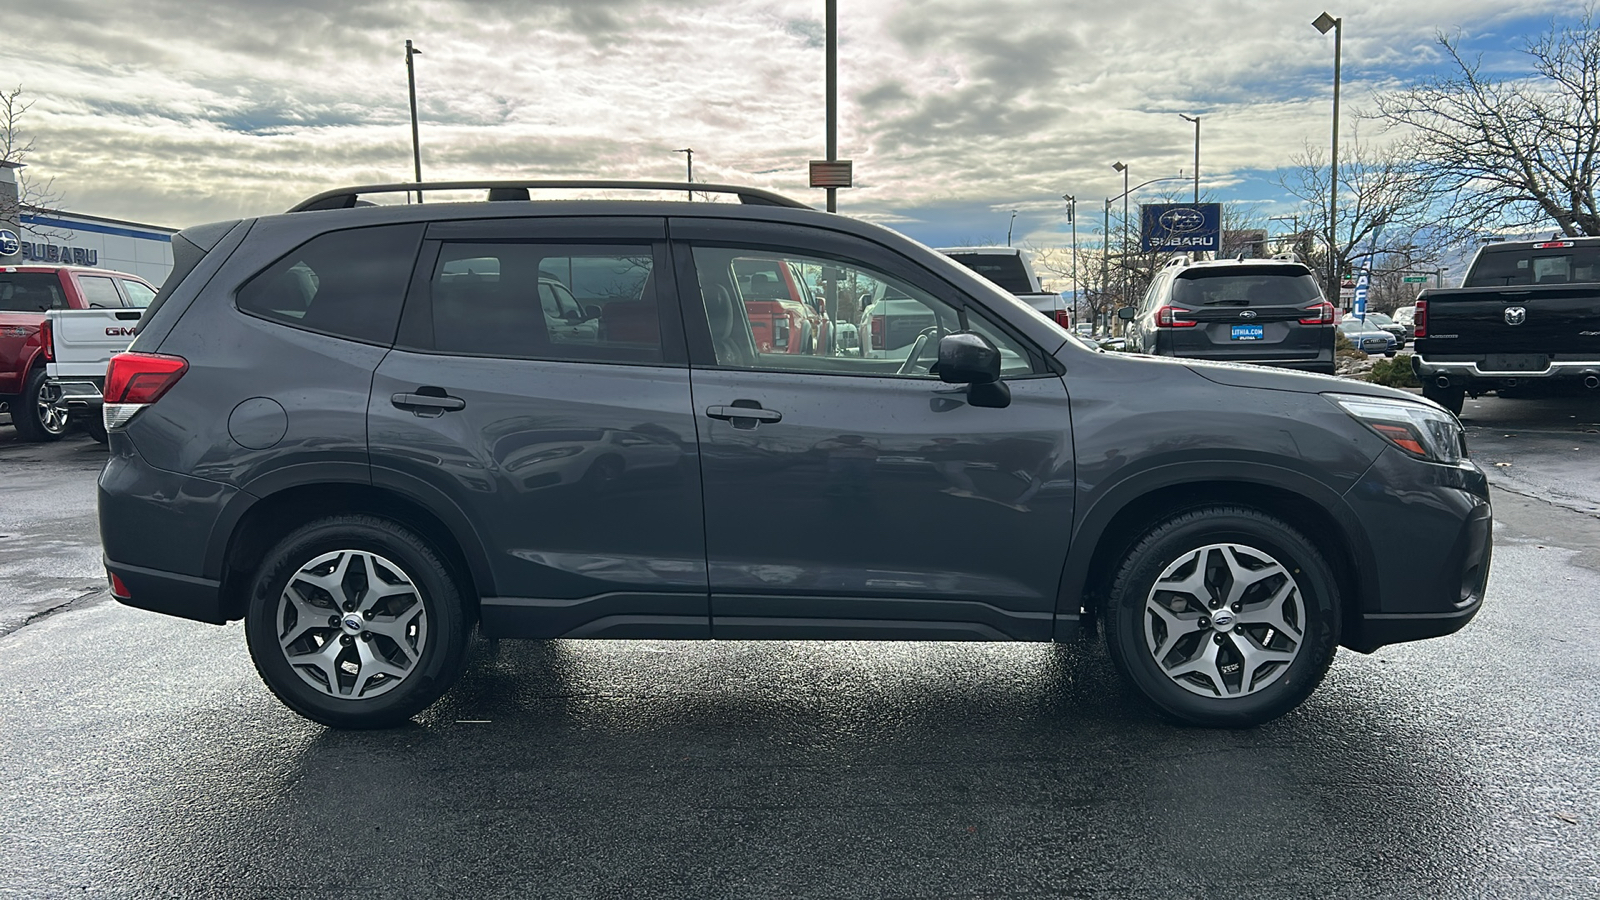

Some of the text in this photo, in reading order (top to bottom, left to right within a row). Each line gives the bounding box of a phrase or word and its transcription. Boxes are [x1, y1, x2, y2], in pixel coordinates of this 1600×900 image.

[1149, 237, 1213, 247] SUBARU
[22, 242, 98, 266] SUBARU
[106, 327, 136, 336] GM
[1231, 328, 1263, 336] LITHIA.COM
